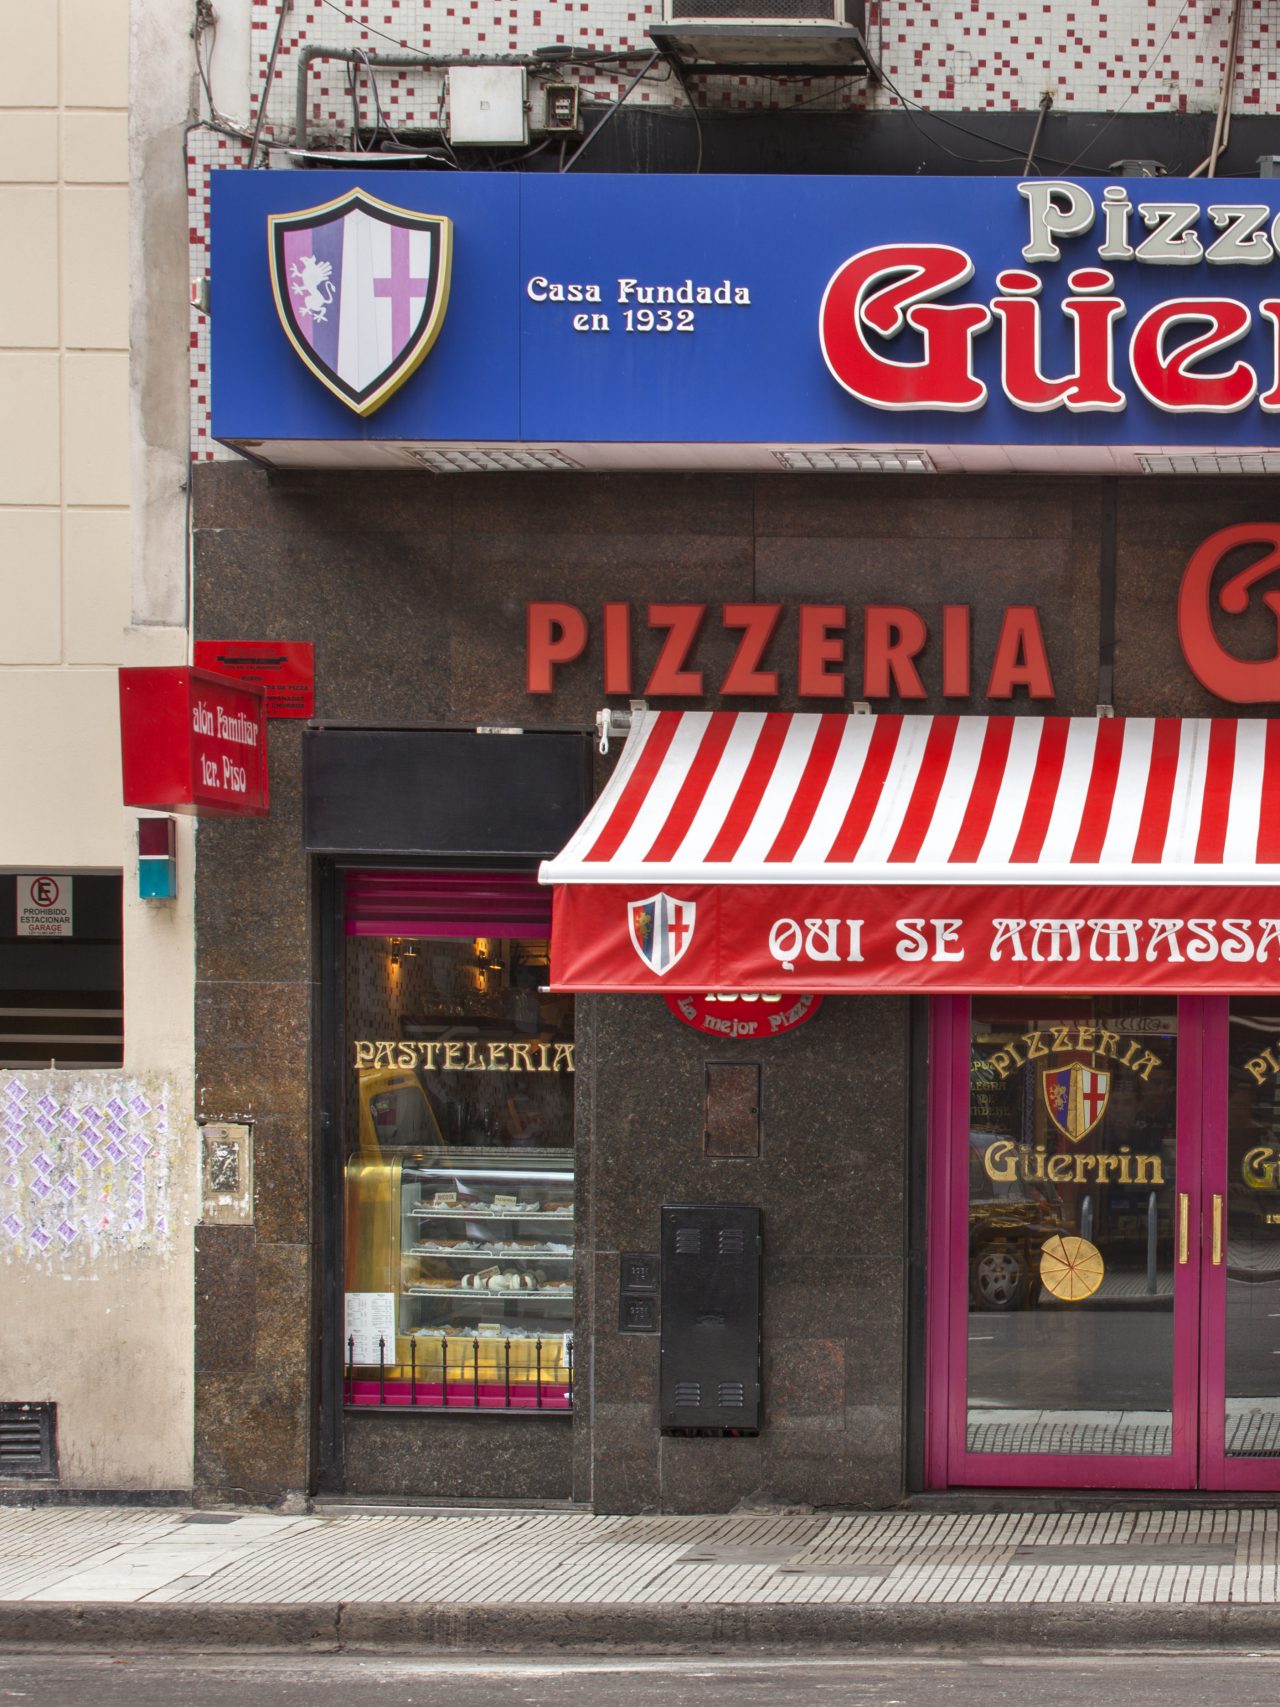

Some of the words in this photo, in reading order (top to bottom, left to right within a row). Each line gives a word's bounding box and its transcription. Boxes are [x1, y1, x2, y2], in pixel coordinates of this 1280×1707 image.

[527, 276, 601, 302] Casa
[617, 279, 751, 304] Fundada
[573, 313, 609, 331] en
[623, 309, 694, 332] 1932
[526, 602, 1056, 698] PIZZERIA
[193, 701, 214, 736] alón
[217, 705, 258, 746] Familiar
[200, 753, 220, 788] 1er.
[222, 755, 246, 792] Piso
[20, 916, 70, 924] ESTACIONAR
[768, 918, 865, 972] QUI
[895, 918, 965, 963] SE
[677, 996, 698, 1021] La
[702, 1014, 758, 1038] mejor
[354, 1040, 575, 1072] PASTELERIA
[988, 1025, 1163, 1081] PIZZERIA
[984, 1140, 1166, 1184] Güerrin
